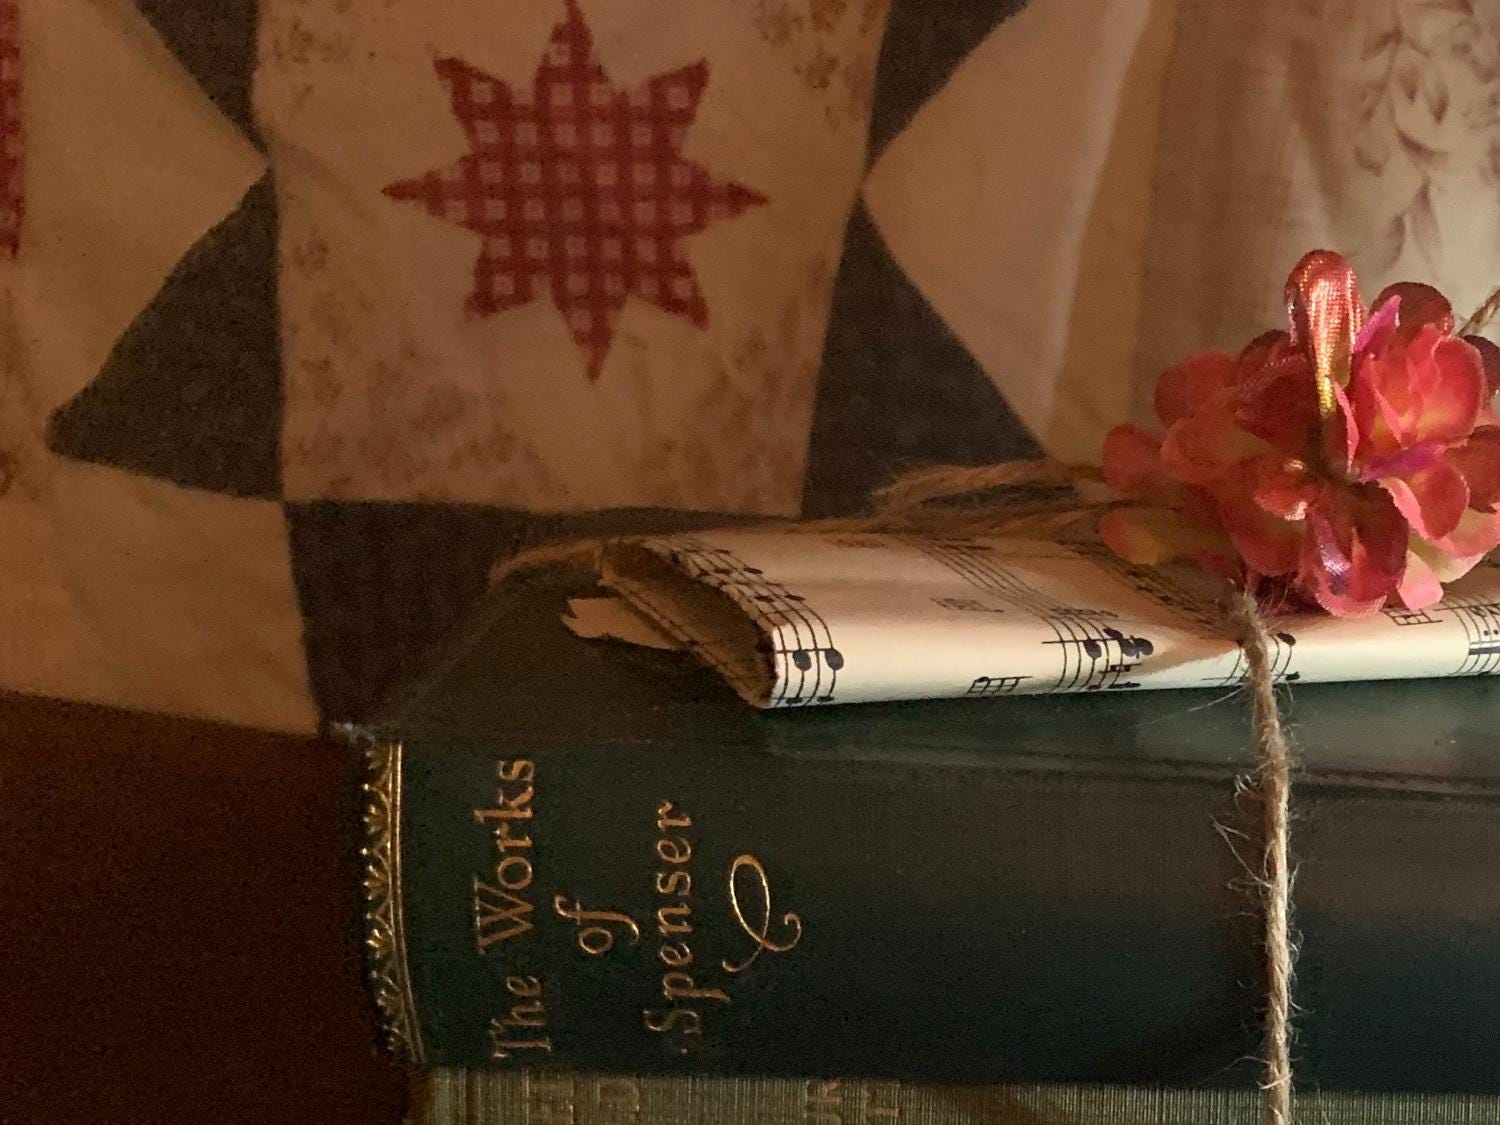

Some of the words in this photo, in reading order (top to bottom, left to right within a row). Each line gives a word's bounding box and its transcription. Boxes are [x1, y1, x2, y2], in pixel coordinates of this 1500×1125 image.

[473, 759, 535, 954] Works
[555, 894, 640, 955] of
[642, 800, 730, 1040] Spenser
[489, 975, 552, 1058] The
